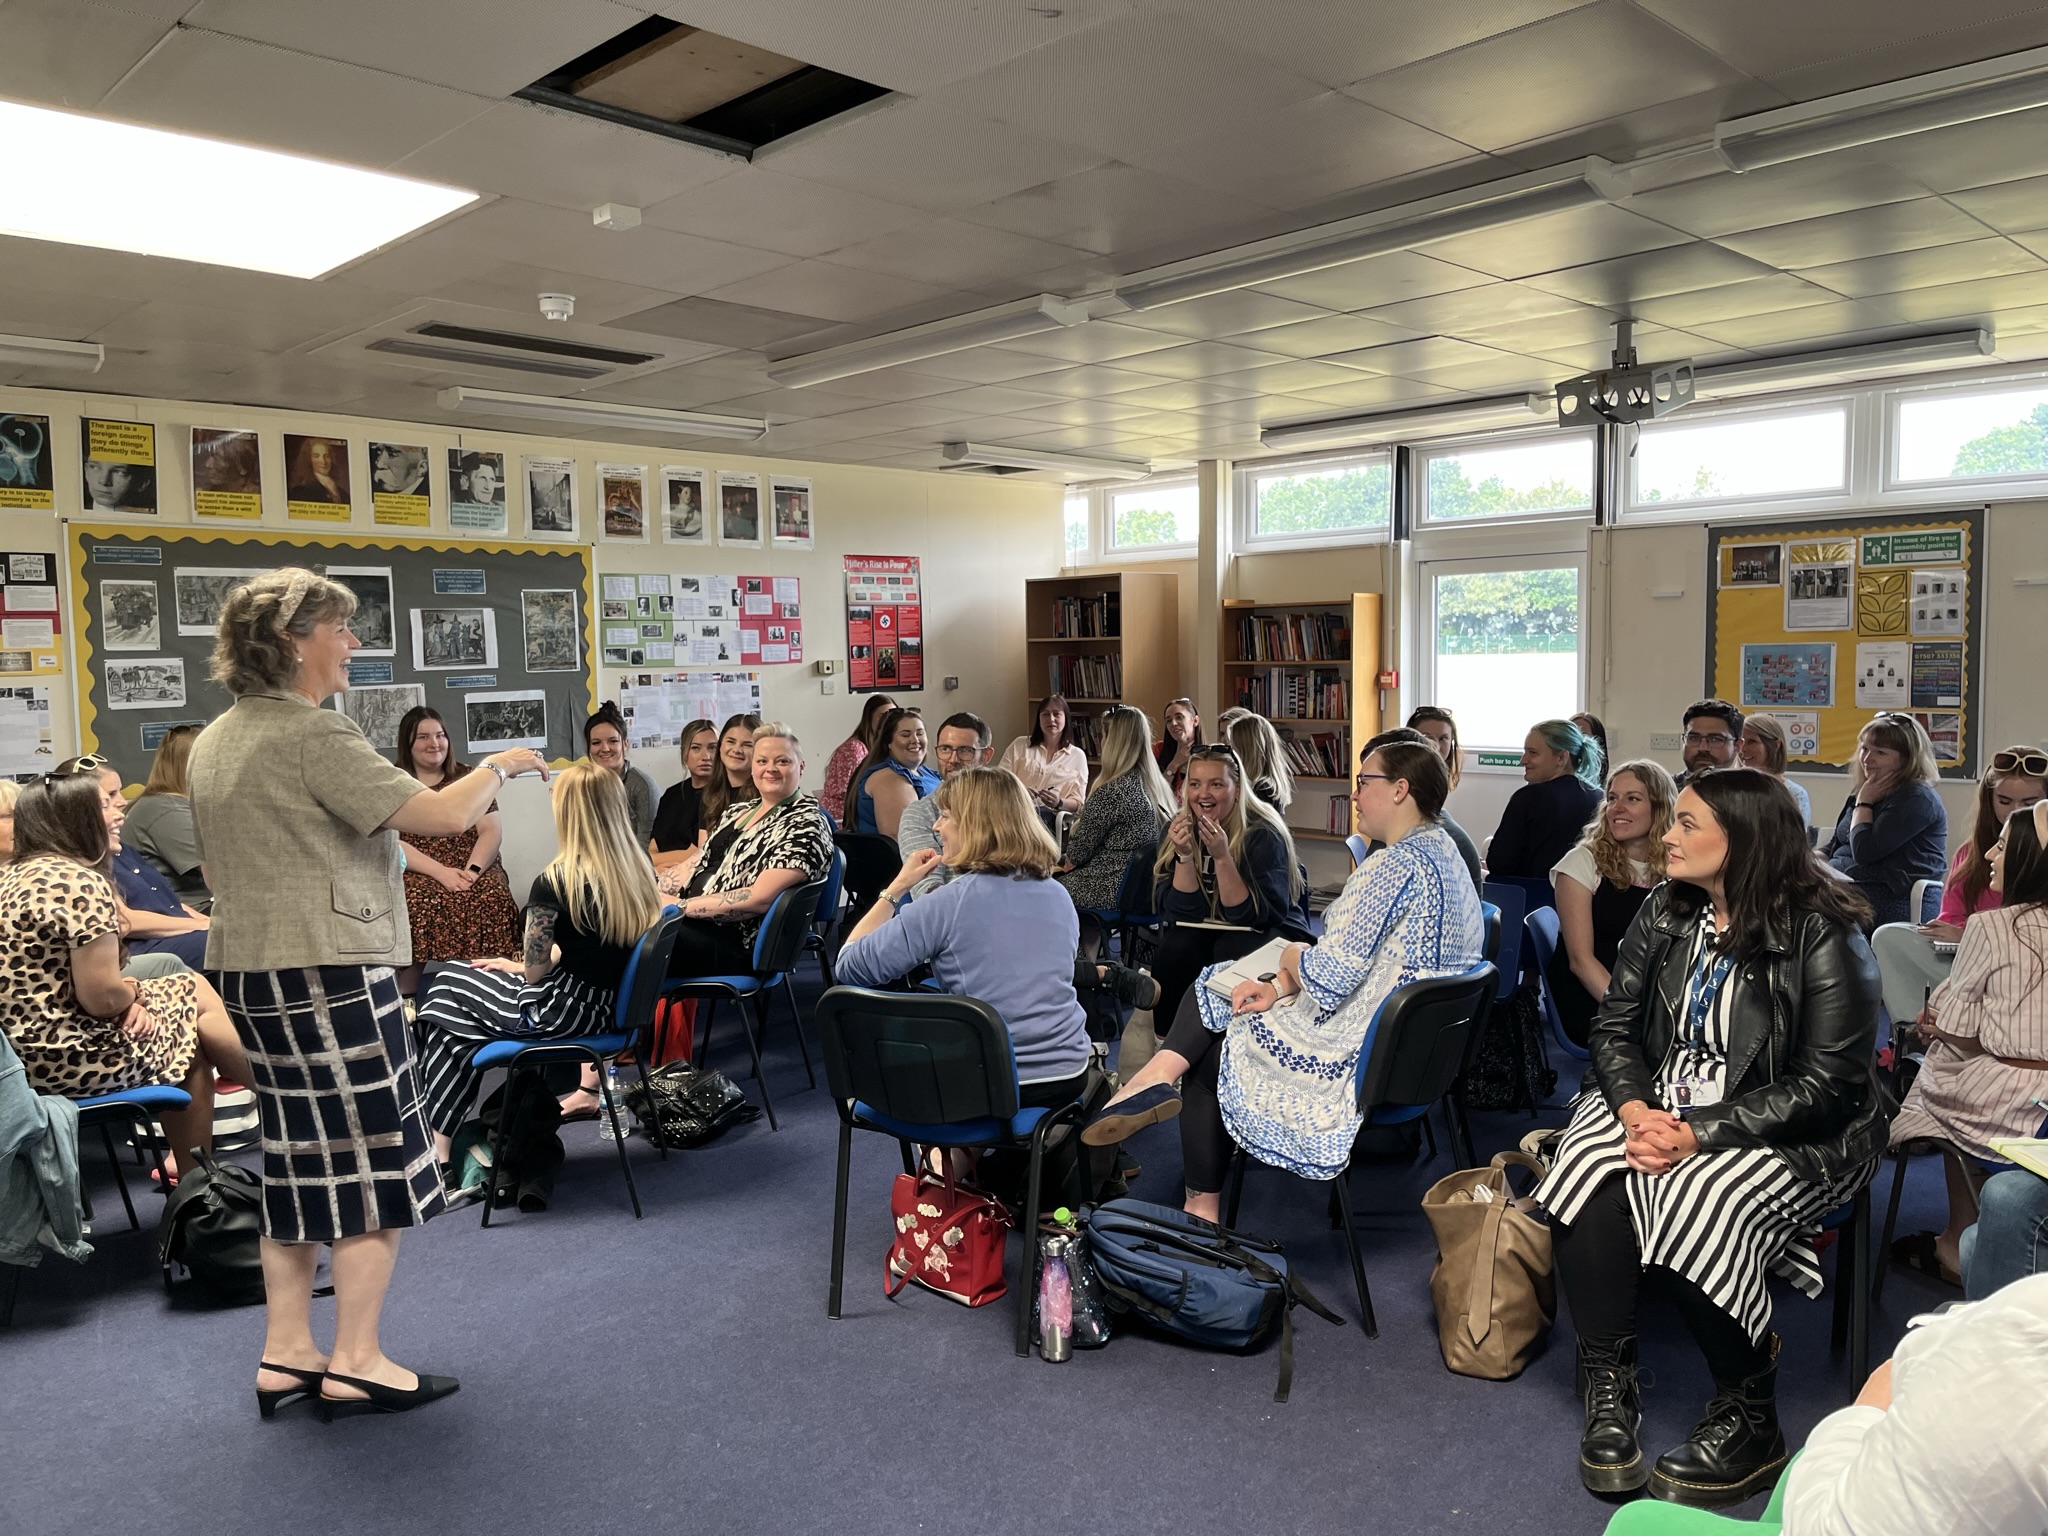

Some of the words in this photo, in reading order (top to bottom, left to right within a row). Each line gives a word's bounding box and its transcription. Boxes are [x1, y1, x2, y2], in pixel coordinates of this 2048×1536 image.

[91, 430, 117, 439] foreign
[119, 433, 150, 442] country:
[91, 438, 107, 446] they
[120, 440, 144, 449] things
[91, 446, 128, 456] differently
[846, 560, 868, 568] Hitler's
[870, 560, 882, 568] Rise
[883, 560, 888, 568] to
[890, 560, 908, 568] Power
[1288, 677, 1296, 714] HITLER
